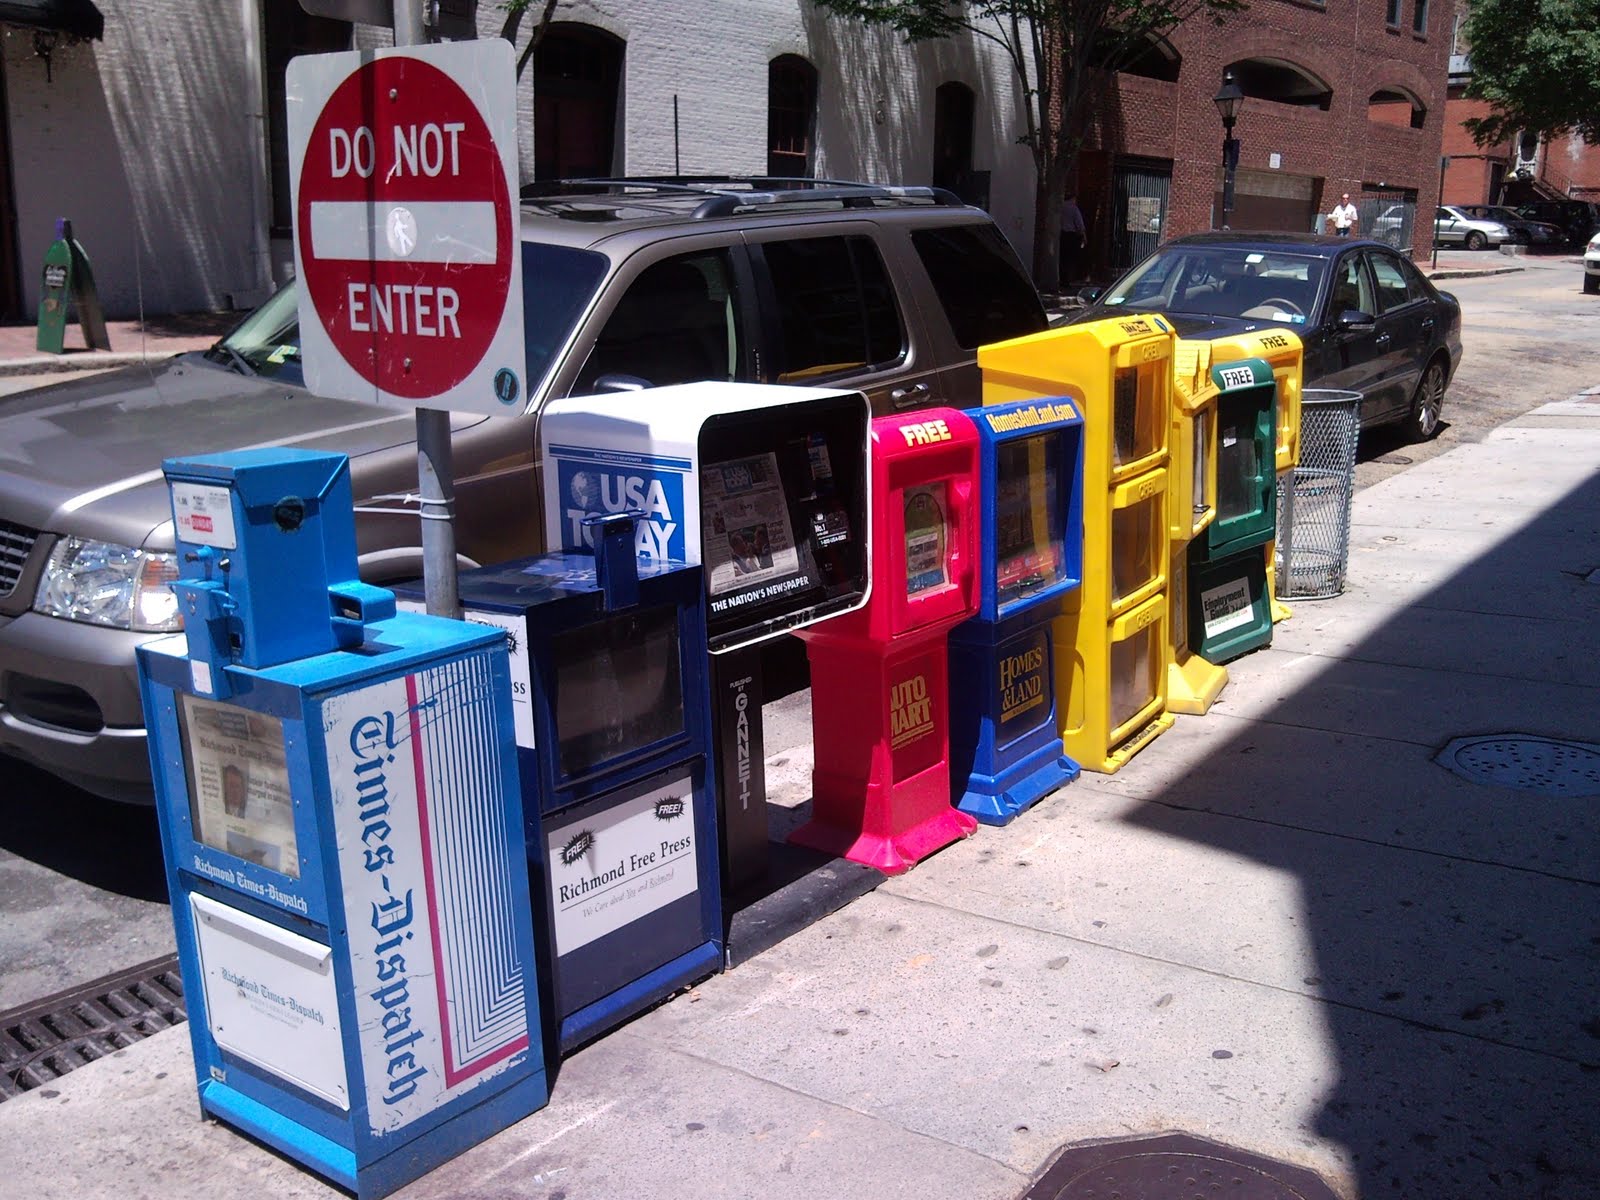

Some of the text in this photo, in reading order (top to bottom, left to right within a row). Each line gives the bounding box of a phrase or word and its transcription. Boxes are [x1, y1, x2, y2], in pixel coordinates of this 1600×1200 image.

[330, 123, 465, 178] DO NOT
[348, 283, 461, 338] ENTER
[1259, 335, 1289, 349] FREE
[1223, 369, 1252, 387] FREE
[898, 419, 952, 447] FREE
[600, 473, 672, 520] USA
[567, 509, 677, 561] TOAY
[711, 600, 728, 612] THE
[728, 588, 766, 608] NATION'S
[766, 576, 810, 597] NEWSPAPER
[1204, 587, 1245, 612] Employment
[1000, 647, 1042, 691] HOMES
[891, 675, 927, 711] UTO
[735, 692, 751, 810] GANNETT
[658, 803, 682, 815] FREE!
[559, 836, 691, 904] Richmond Free Press
[565, 834, 591, 861] FREE!
[194, 855, 308, 914] Richmond Times-Dispatch
[350, 711, 428, 1105] Times-Dispatch
[221, 967, 259, 994] Richmond
[260, 984, 324, 1026] Times-Dispatch
